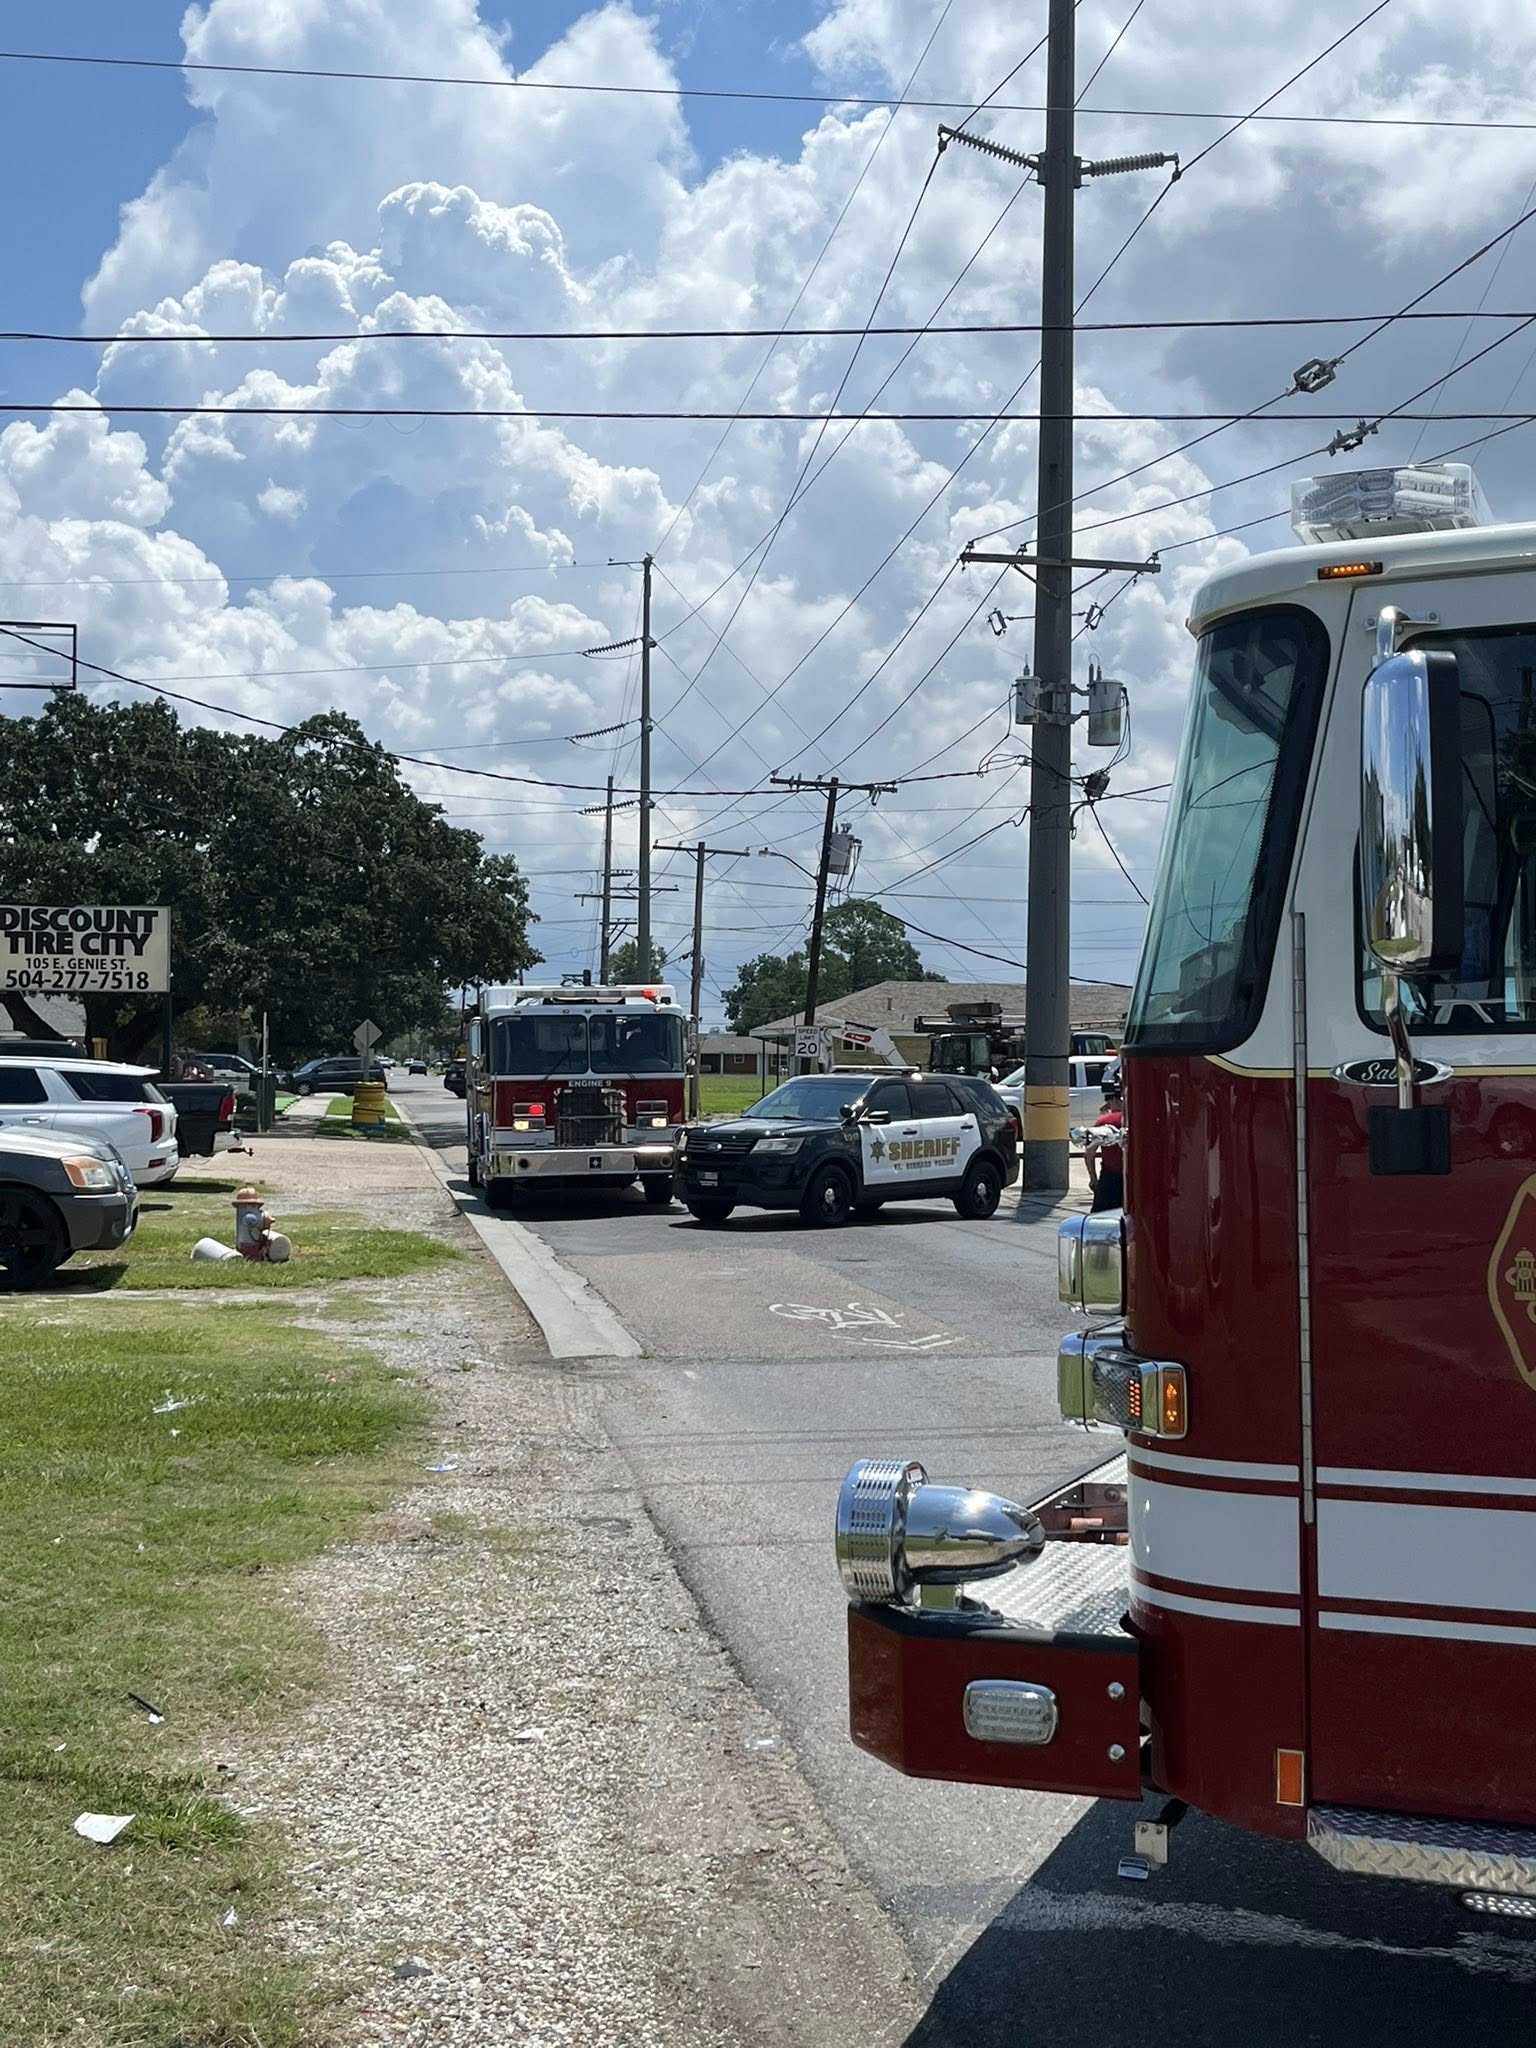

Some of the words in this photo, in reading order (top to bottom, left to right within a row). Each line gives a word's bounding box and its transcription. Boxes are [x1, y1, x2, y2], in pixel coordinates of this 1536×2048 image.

[0, 907, 159, 933] DISCOUNT
[4, 931, 74, 955] TIRE
[80, 932, 151, 956] CITY
[25, 957, 49, 969] 105
[53, 957, 65, 969] E.
[67, 958, 107, 970] GENIE
[110, 958, 130, 971] ST.
[5, 969, 149, 990] 504-277-7518
[797, 1027, 817, 1035] SPEED
[797, 1042, 818, 1055] 20
[888, 1136, 961, 1161] SHERIFF
